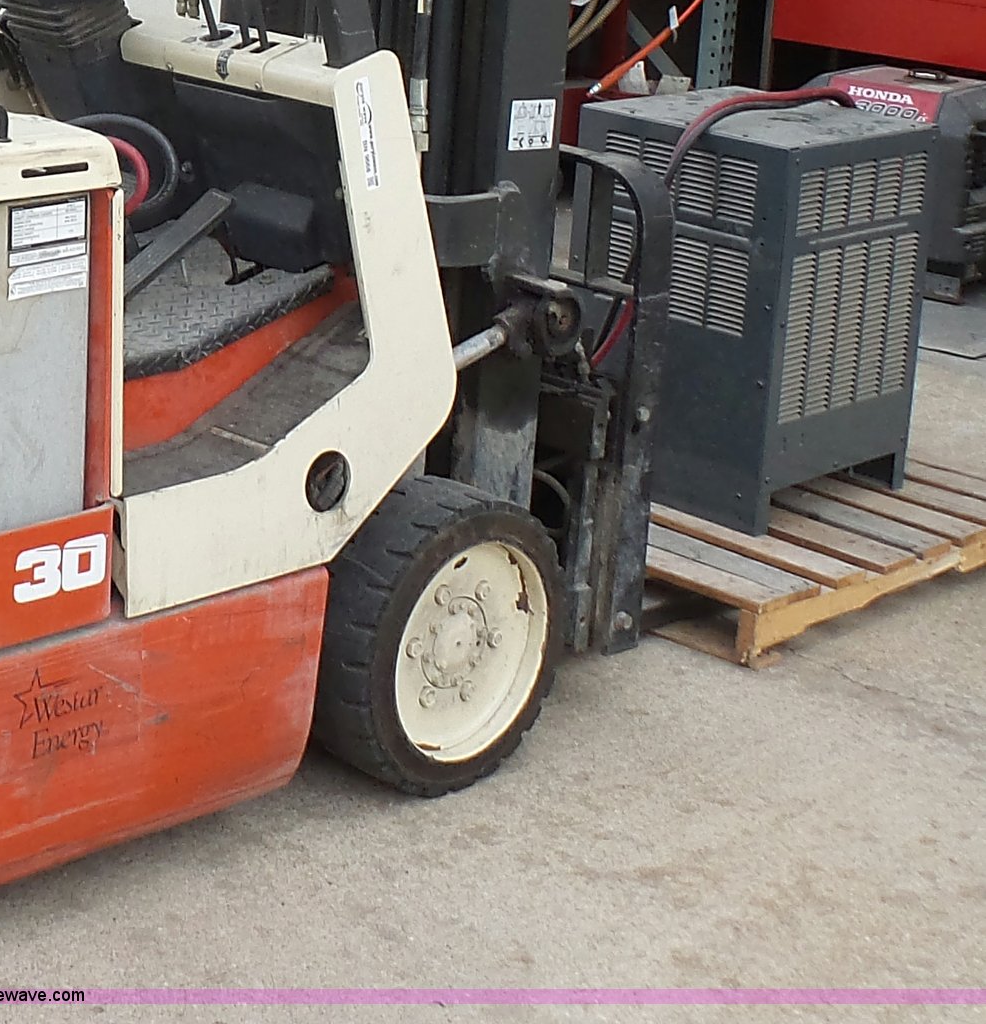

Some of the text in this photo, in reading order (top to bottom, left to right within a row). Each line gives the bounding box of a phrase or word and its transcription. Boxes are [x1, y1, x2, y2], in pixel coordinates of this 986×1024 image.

[848, 85, 914, 105] HONDA
[13, 532, 108, 604] 30
[32, 684, 105, 724] Westar
[32, 719, 105, 760] Energy
